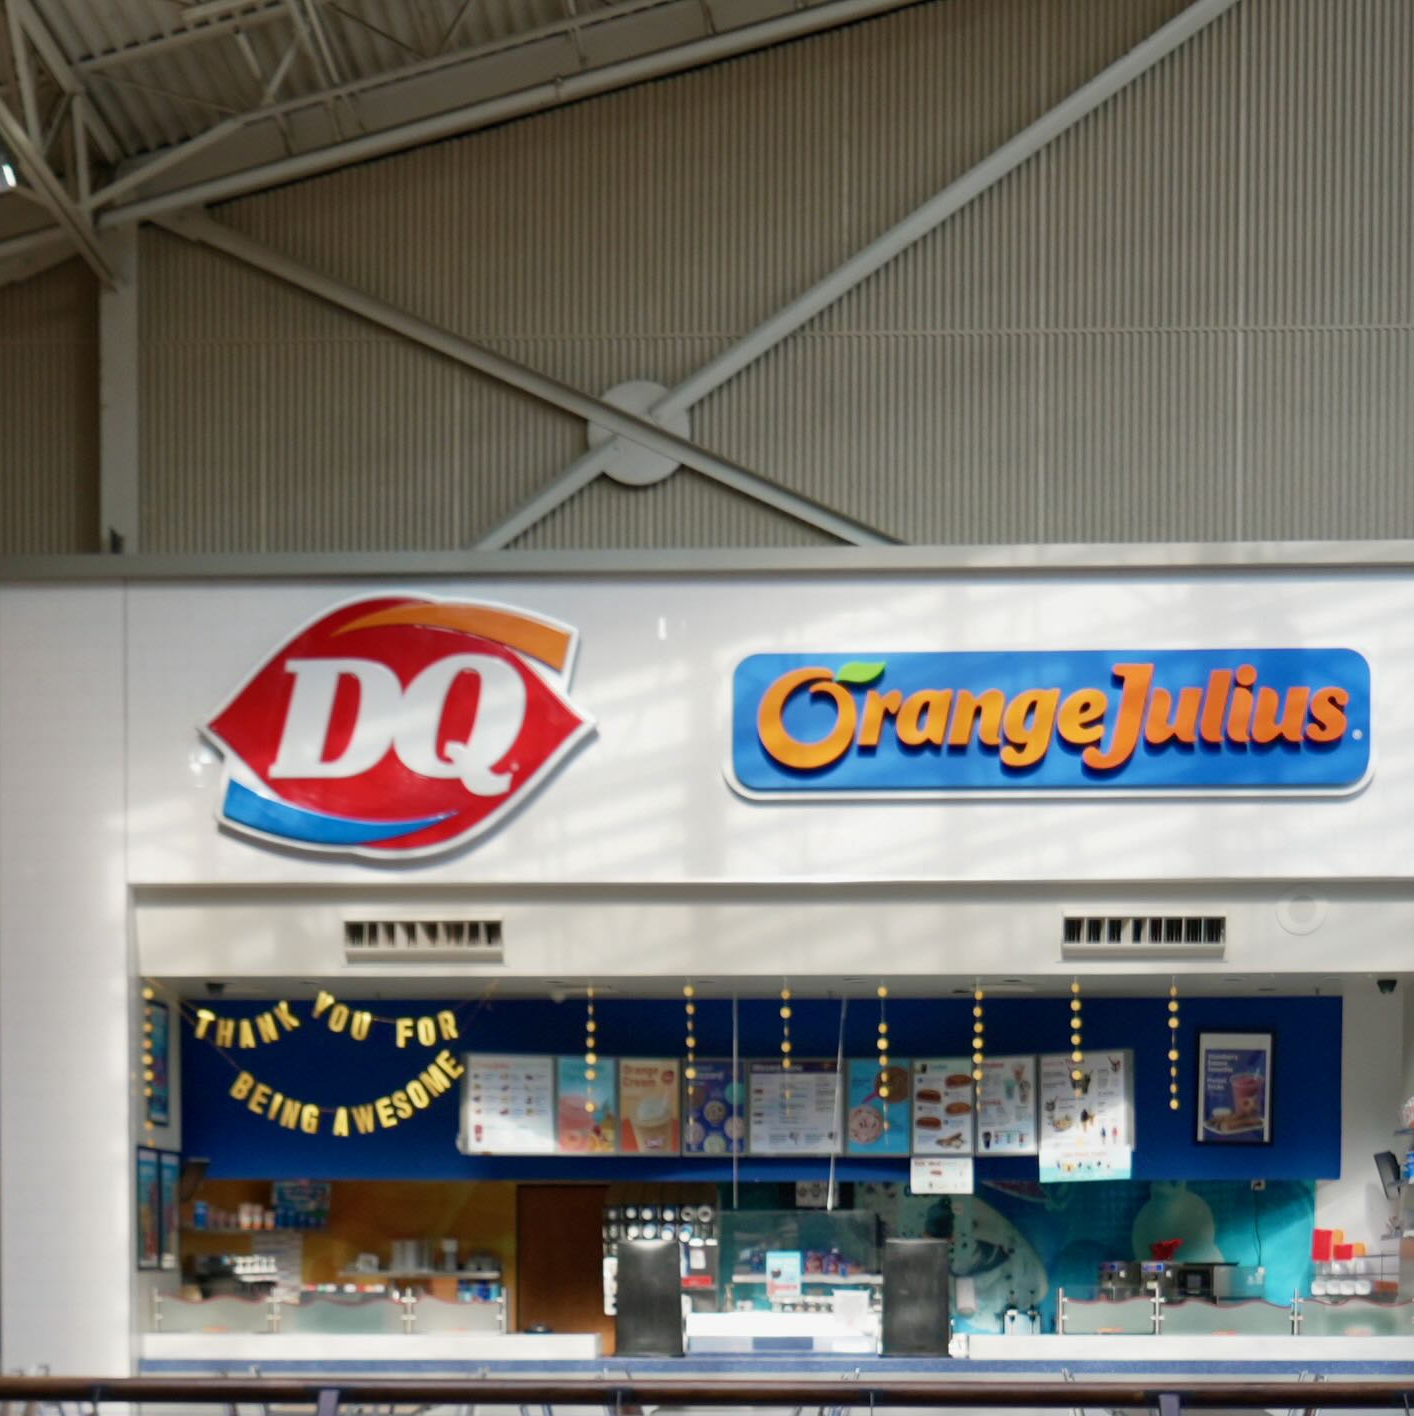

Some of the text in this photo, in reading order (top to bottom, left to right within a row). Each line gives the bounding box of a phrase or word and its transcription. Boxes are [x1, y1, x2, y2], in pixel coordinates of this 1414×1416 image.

[268, 653, 527, 797] DQ
[194, 990, 459, 1049] THANK YOU FOR
[229, 1050, 465, 1137] BEING AWESOME
